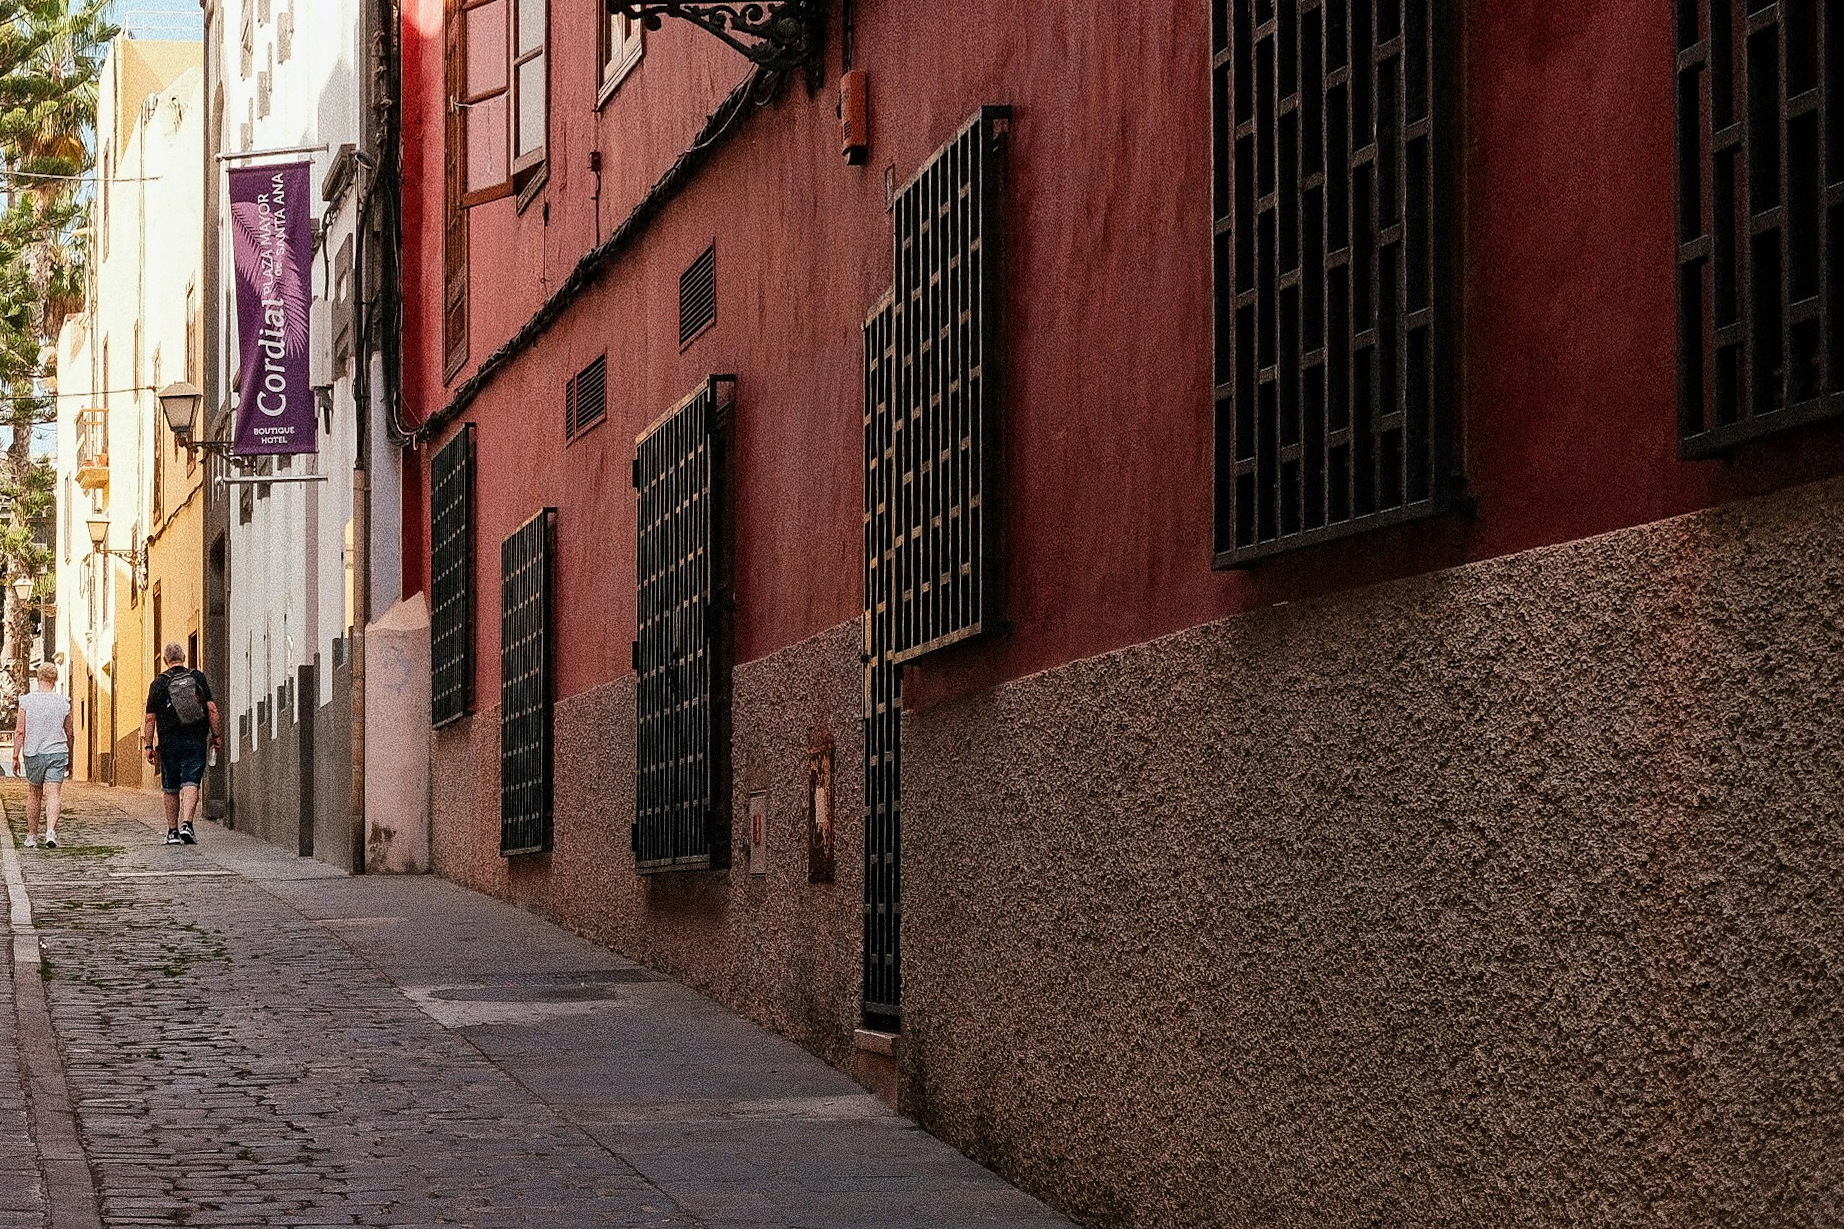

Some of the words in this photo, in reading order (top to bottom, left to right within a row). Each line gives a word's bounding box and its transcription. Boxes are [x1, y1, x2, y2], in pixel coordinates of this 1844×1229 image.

[272, 172, 285, 205] ANA
[258, 192, 272, 245] MAYOR
[274, 208, 286, 255] SANTA
[261, 249, 273, 295] PLAZA
[257, 295, 287, 417] Cordial
[253, 426, 296, 435] BOUTIQUE
[261, 436, 288, 444] HOTEL
